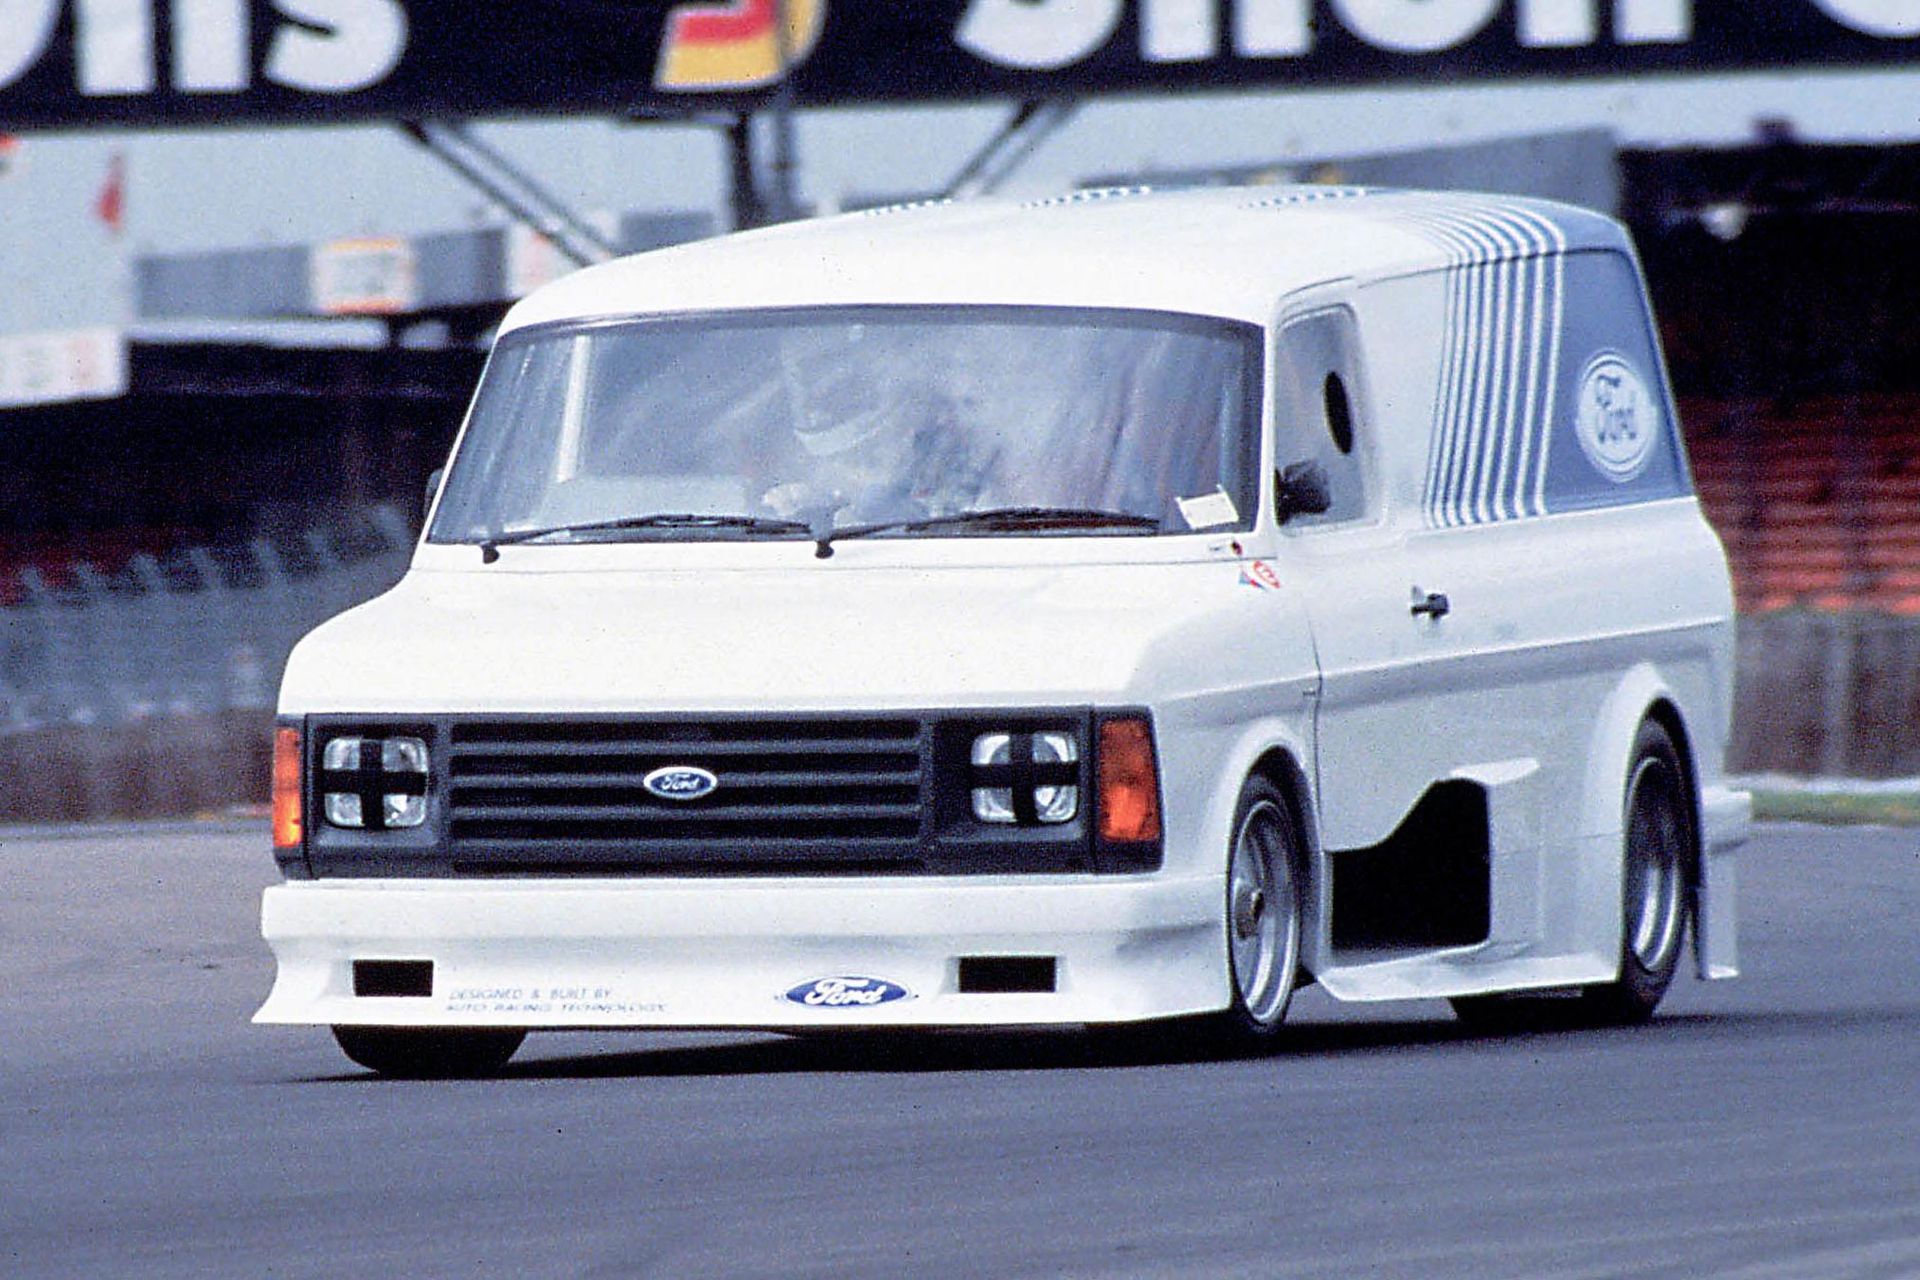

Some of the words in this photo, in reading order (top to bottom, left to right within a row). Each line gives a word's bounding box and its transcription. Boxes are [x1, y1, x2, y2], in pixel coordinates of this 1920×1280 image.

[660, 773, 700, 790] Ford
[449, 987, 523, 1000] DESIGNED
[531, 988, 541, 999] &
[550, 988, 587, 999] BUILT
[594, 988, 612, 999] BY
[804, 978, 888, 1006] Ford
